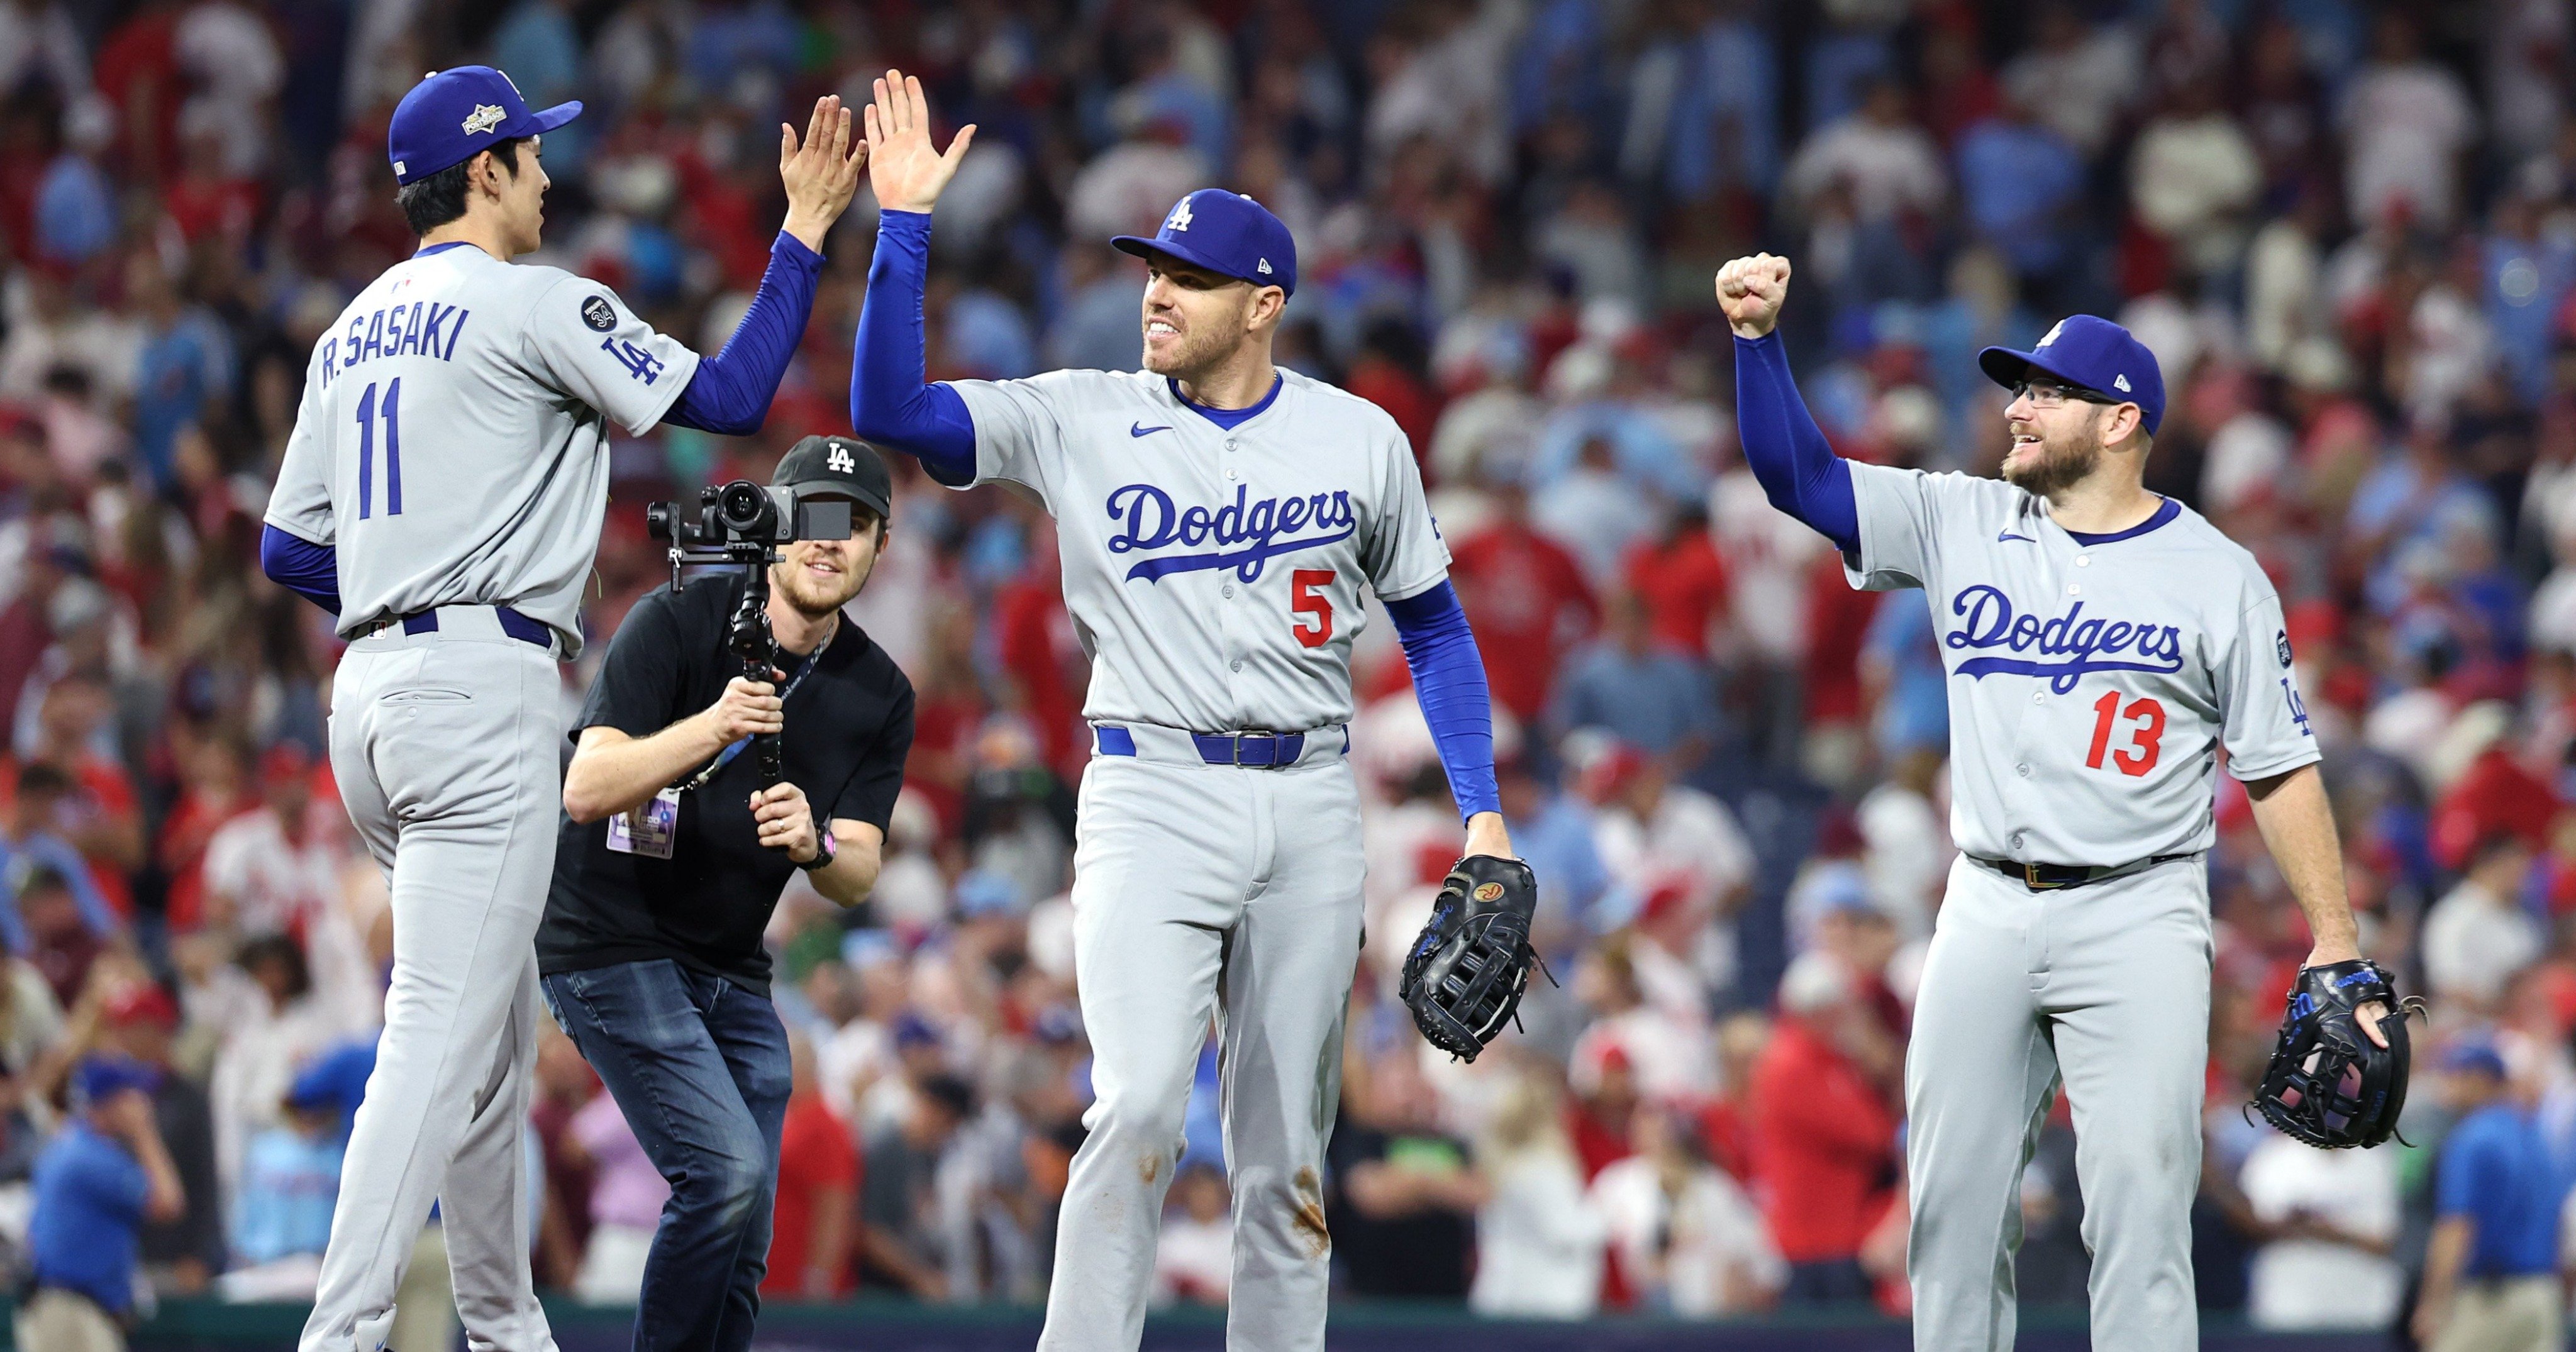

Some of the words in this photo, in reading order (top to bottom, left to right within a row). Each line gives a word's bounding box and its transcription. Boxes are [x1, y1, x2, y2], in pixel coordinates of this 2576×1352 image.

[1167, 196, 1193, 231] LA
[591, 305, 614, 327] 34
[601, 336, 665, 386] LA
[357, 377, 402, 520] 11
[827, 443, 855, 474] LA
[1107, 484, 1356, 586] Dodgers
[1291, 570, 1336, 648] 5
[1946, 585, 2184, 695] Dodgers
[2085, 690, 2166, 777] 13
